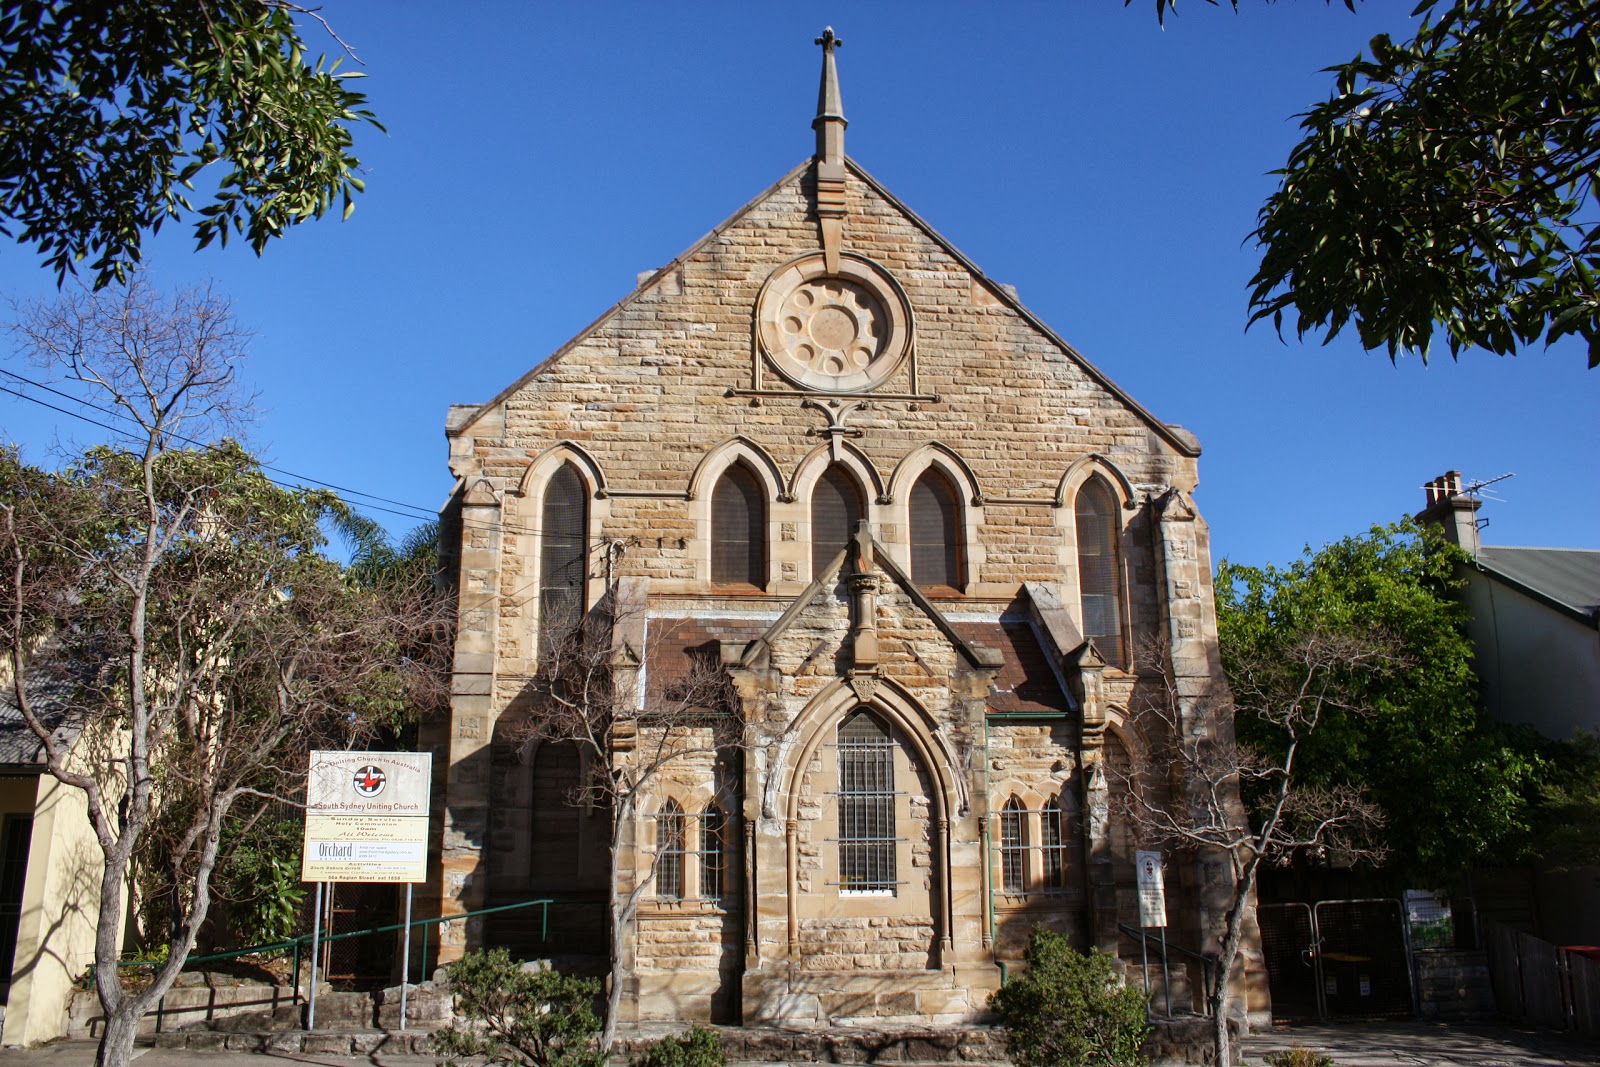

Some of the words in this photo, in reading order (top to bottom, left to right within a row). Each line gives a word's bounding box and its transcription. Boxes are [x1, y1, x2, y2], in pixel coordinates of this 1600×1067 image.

[329, 757, 356, 766] Uniting
[390, 760, 421, 773] Australia
[318, 802, 338, 810] South
[339, 802, 366, 811] Sydney
[366, 802, 392, 811] Uniting
[319, 843, 352, 857] Orchard
